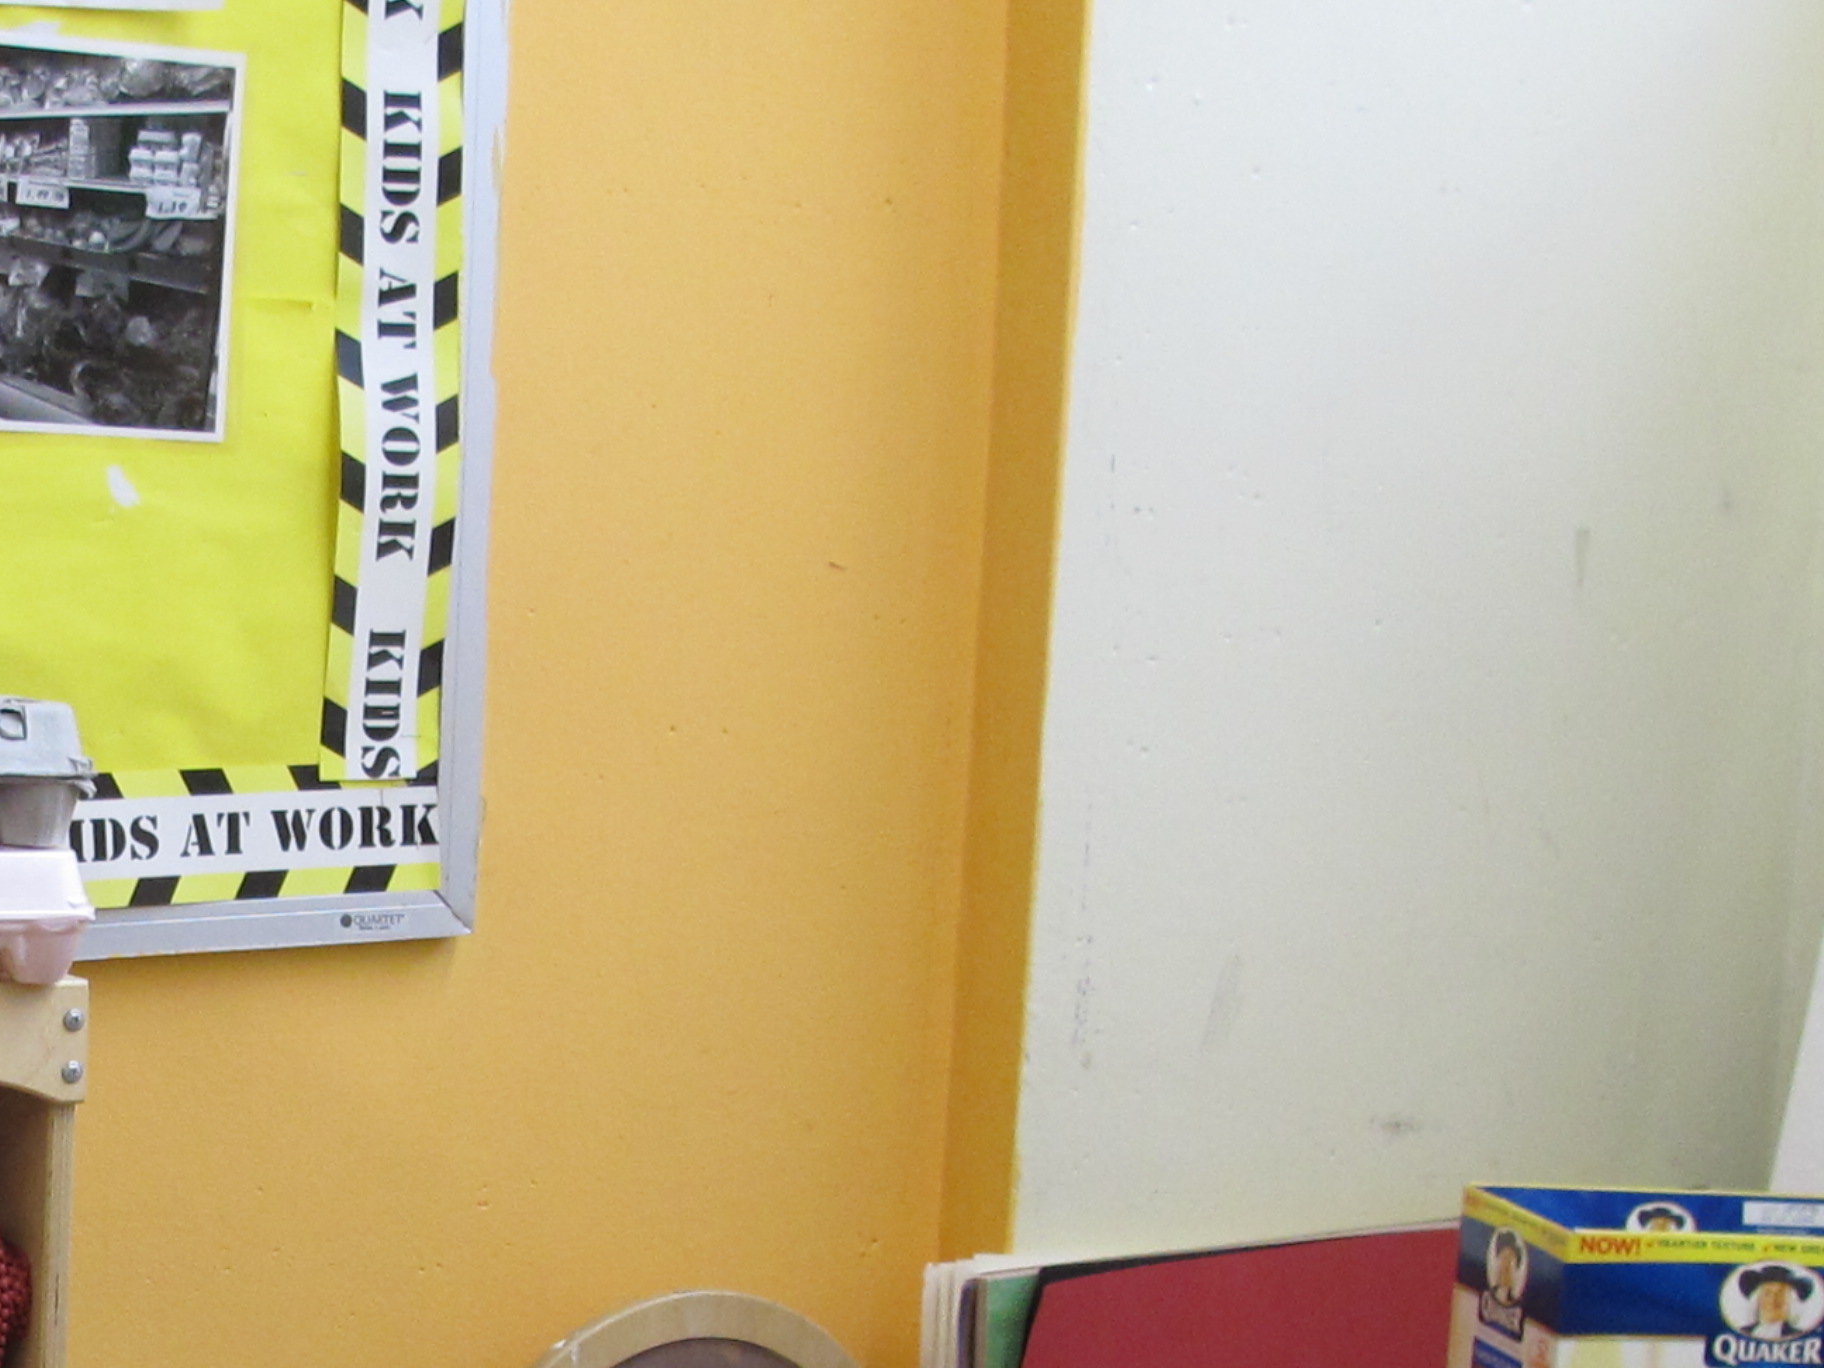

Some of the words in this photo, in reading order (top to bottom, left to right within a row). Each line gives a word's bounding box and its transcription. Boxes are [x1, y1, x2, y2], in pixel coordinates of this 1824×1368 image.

[381, 90, 422, 246] KIDS
[377, 268, 417, 349] AT
[376, 373, 421, 562] WORK
[360, 629, 407, 779] KIDS
[69, 815, 159, 863] IDS
[180, 812, 250, 857] AT
[270, 802, 440, 854] WORK
[1580, 1237, 1642, 1256] NOW!
[1713, 1334, 1823, 1366] QUAKER
